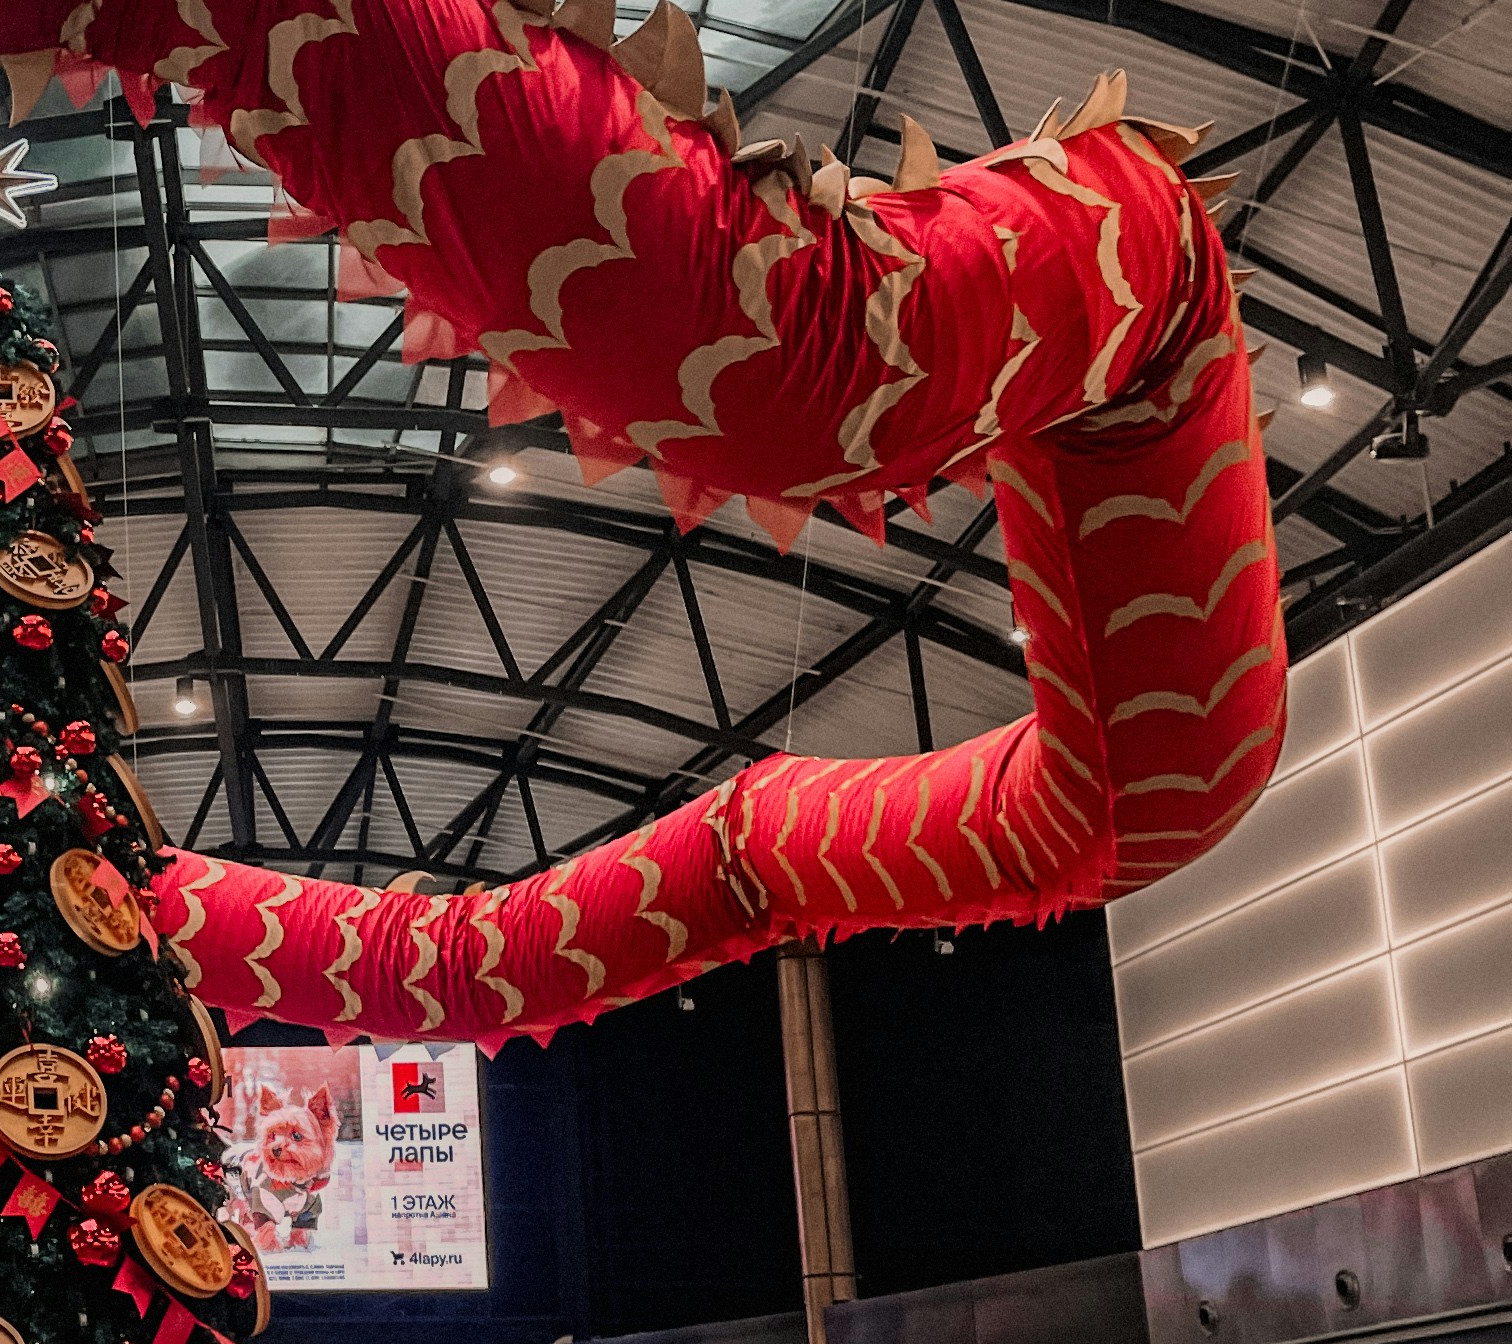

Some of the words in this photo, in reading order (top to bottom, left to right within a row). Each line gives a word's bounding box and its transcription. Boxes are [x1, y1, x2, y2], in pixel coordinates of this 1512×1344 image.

[375, 1122, 468, 1142] четыре
[388, 1144, 454, 1164] лапы
[391, 1195, 398, 1211] 1
[402, 1194, 456, 1211] ЭТАЖ
[409, 1252, 463, 1267] 4lapy.ru
